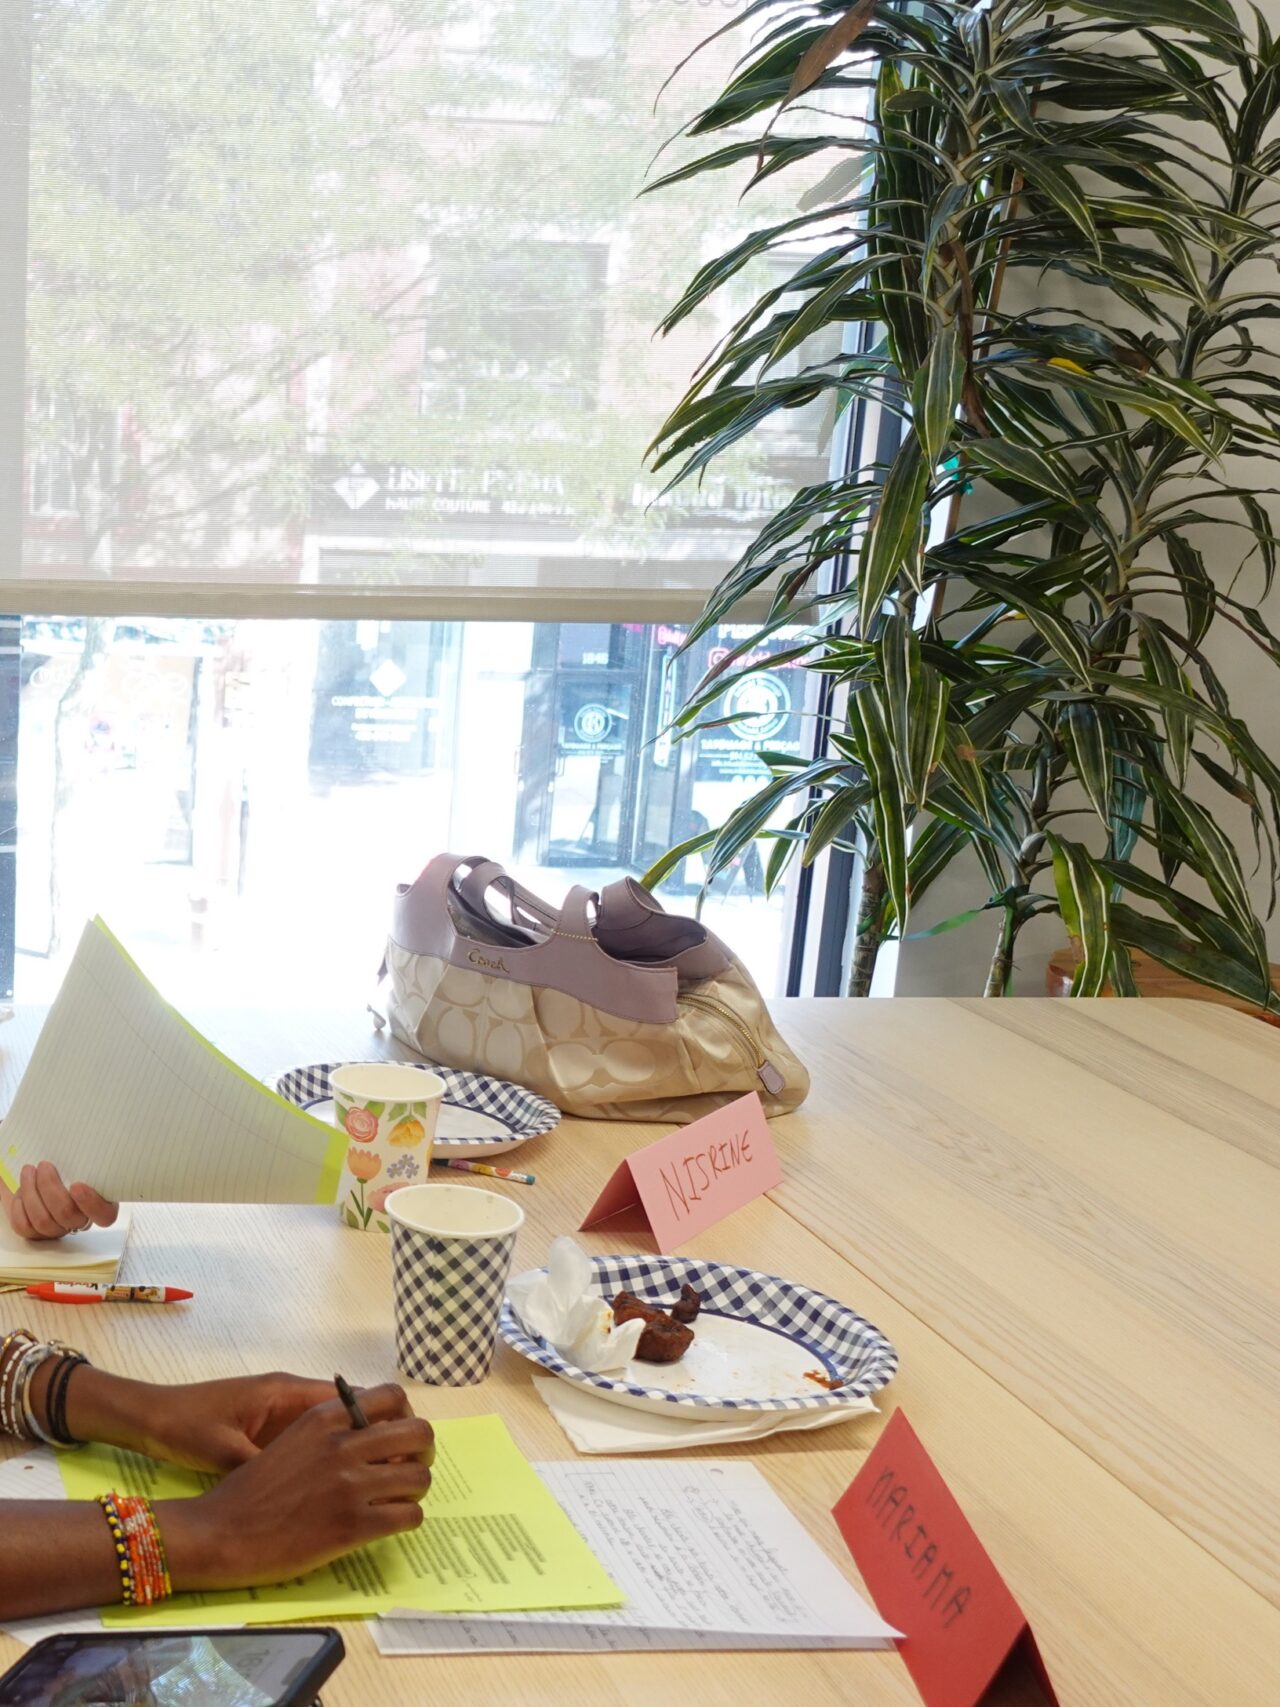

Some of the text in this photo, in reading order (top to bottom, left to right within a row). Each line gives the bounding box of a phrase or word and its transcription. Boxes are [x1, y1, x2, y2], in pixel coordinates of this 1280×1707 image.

[432, 498, 491, 514] COUTURE
[659, 1129, 753, 1221] NISRINE
[865, 1468, 972, 1629] MARIAMA
